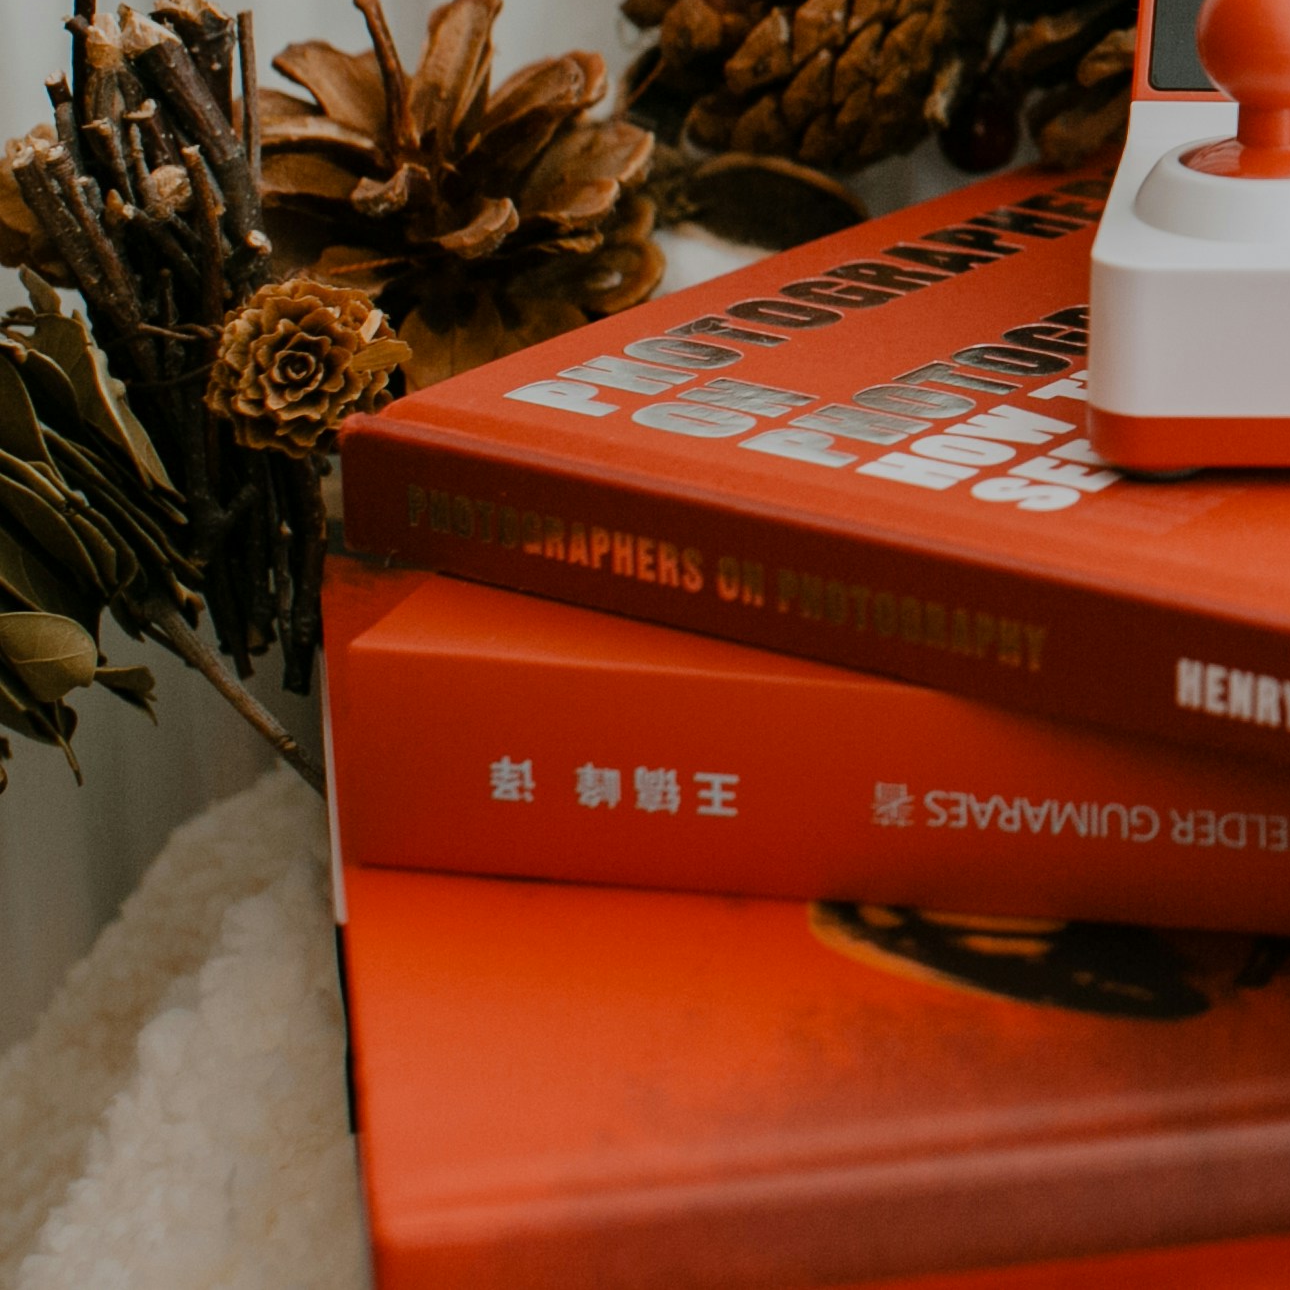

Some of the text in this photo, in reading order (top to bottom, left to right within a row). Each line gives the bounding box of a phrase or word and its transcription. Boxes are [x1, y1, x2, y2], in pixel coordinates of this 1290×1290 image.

[502, 167, 1117, 417] PHOTOGRAPHER
[855, 403, 1077, 491] HOW
[406, 483, 1046, 673] PHOTOGRAPHERS ON PHOTOGRAPHY
[923, 790, 1161, 843] GUIMARAES
